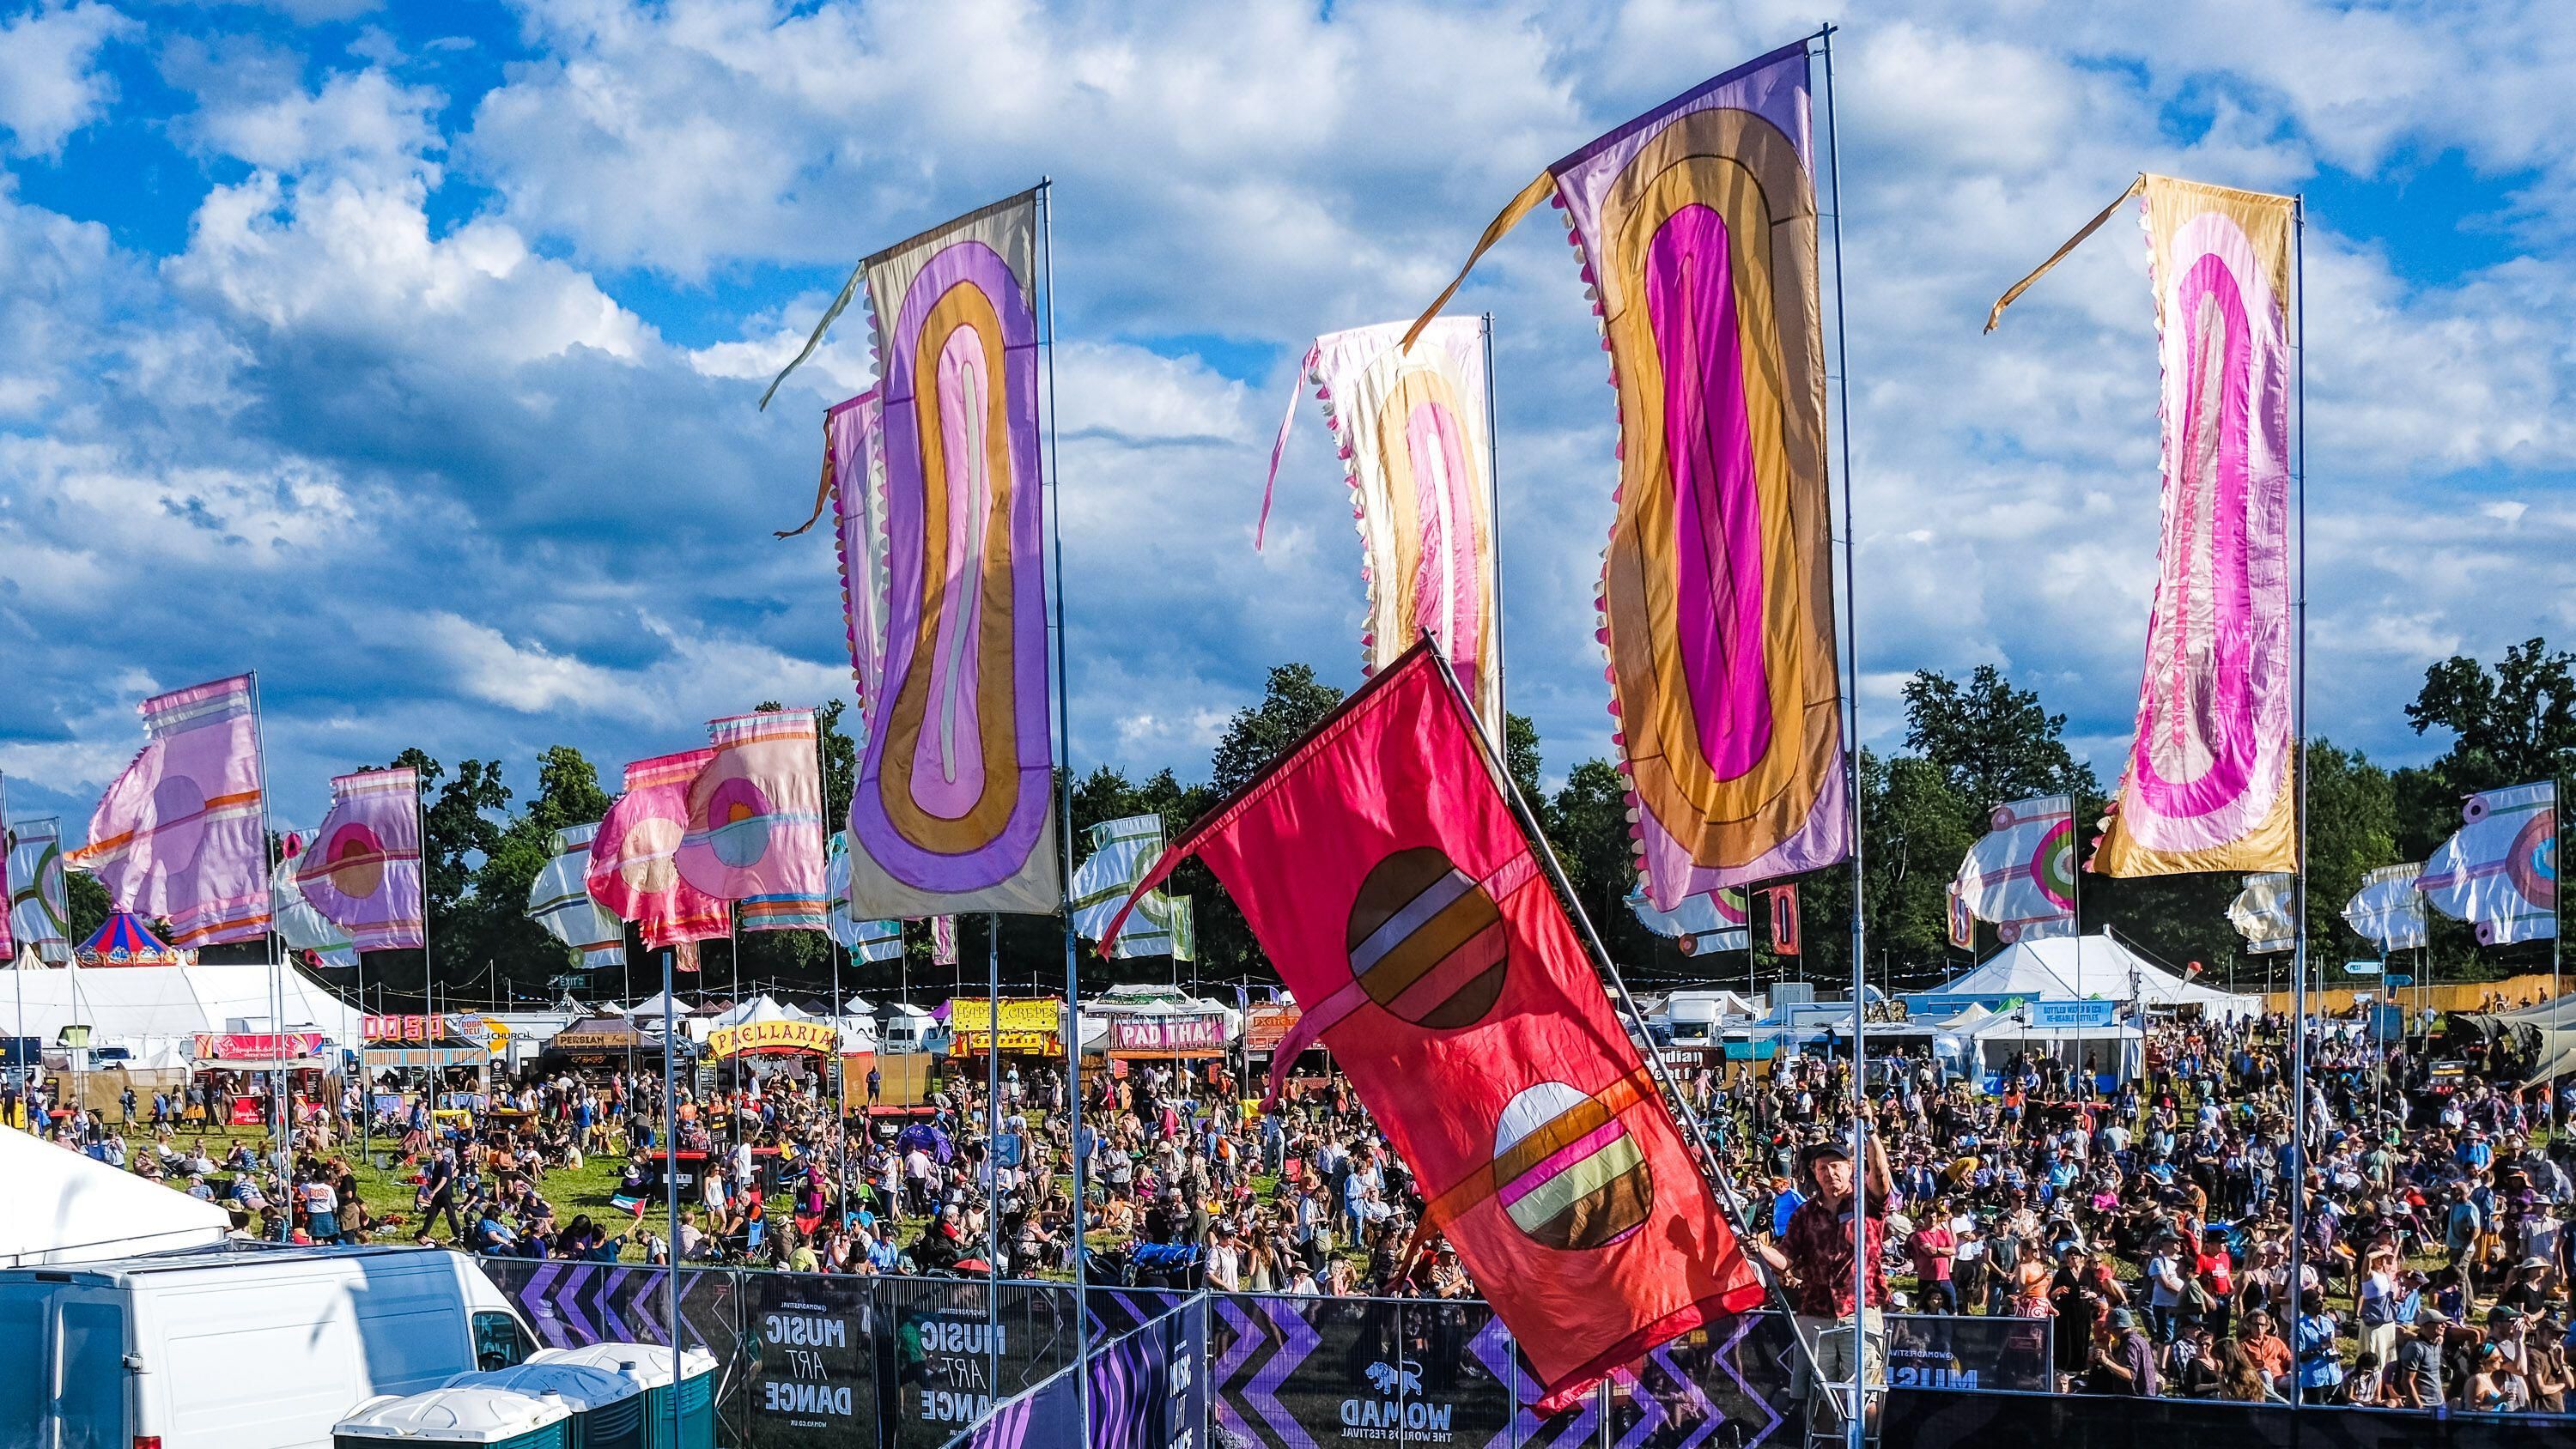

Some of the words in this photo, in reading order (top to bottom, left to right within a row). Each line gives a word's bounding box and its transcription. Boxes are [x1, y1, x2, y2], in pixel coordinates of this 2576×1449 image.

[560, 978, 577, 986] EXIT
[1008, 1006, 1058, 1019] CREPES
[560, 1035, 605, 1046] PERSIAN
[719, 1024, 829, 1051] PAELLARIA
[1123, 1024, 1160, 1046] PAD
[1165, 1022, 1212, 1043] THAI
[1649, 1050, 1703, 1064] ndian
[1170, 1353, 1192, 1398] MUSIC
[1174, 1393, 1188, 1434] ART
